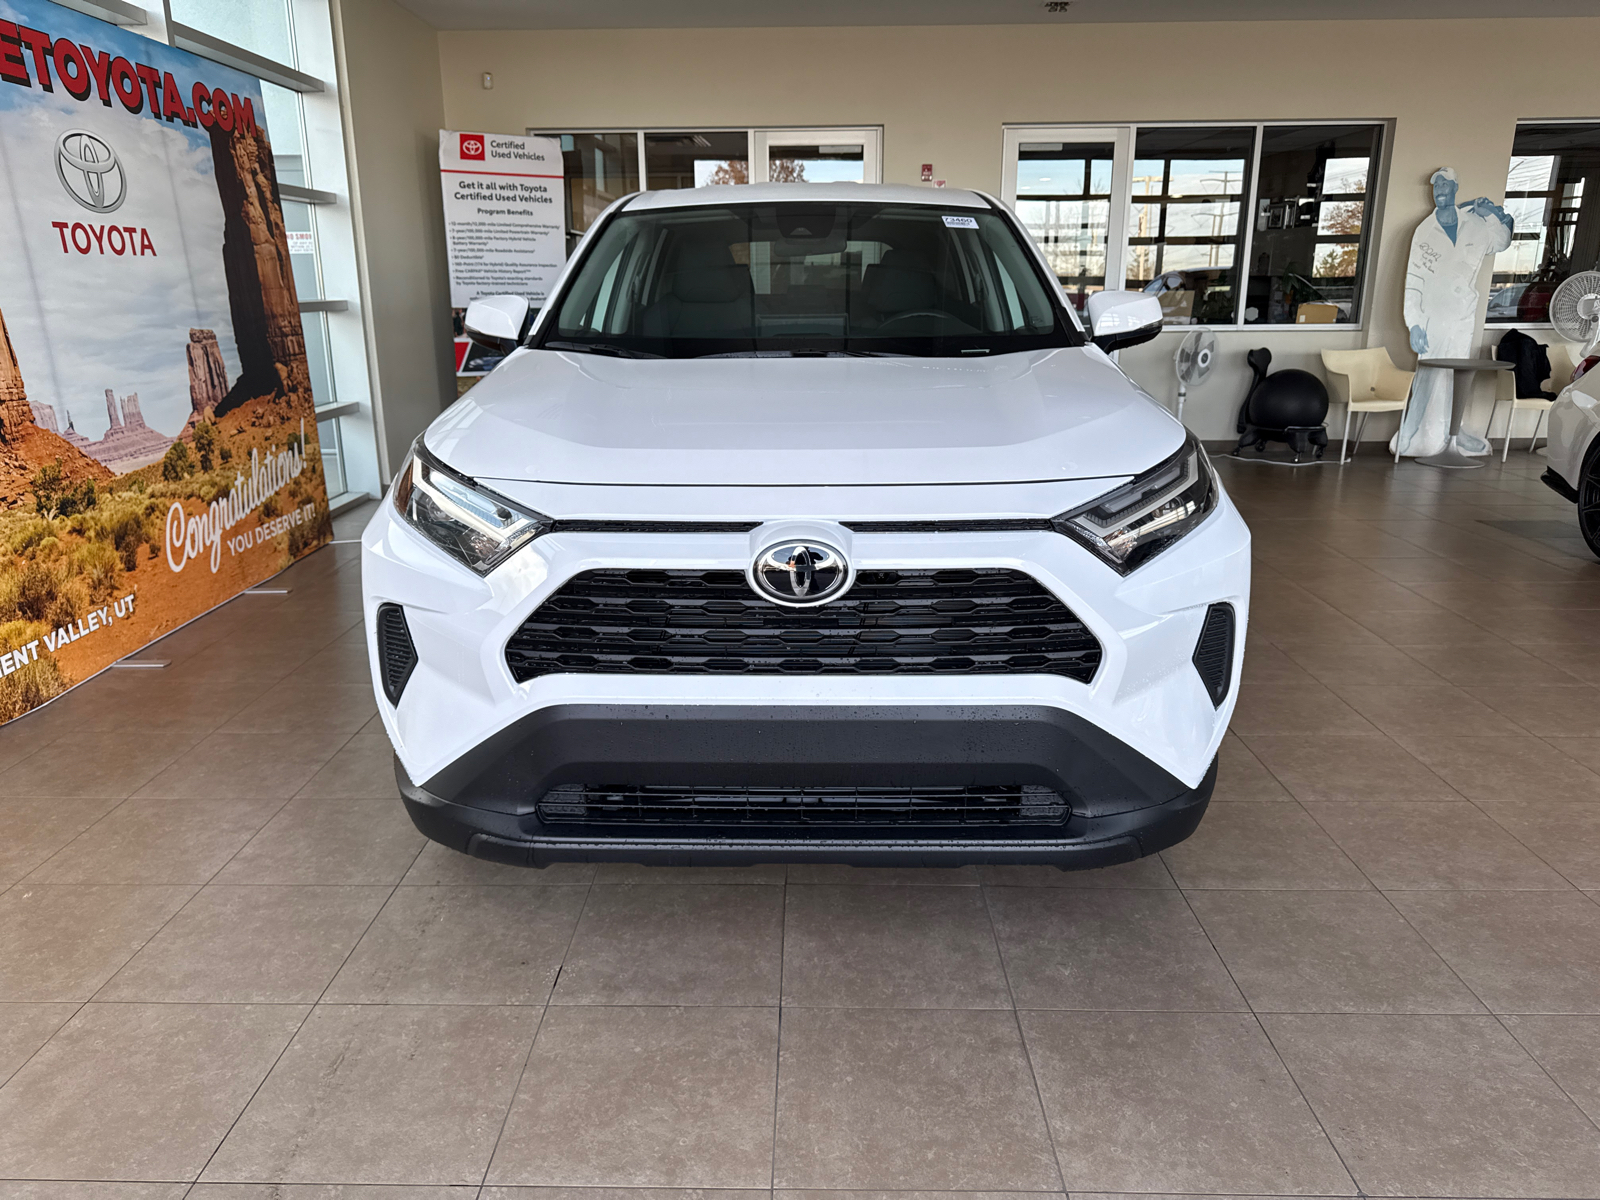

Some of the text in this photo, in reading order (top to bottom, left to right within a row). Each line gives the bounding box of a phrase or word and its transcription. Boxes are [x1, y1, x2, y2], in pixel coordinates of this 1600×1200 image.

[490, 140, 525, 150] Certified
[491, 150, 545, 161] Used Vehicles
[454, 192, 493, 201] Certified
[518, 194, 552, 204] Vehicles
[459, 181, 547, 194] Get it all with Toyota
[52, 222, 157, 256] TOYOTA
[166, 416, 307, 574] Congratulations!
[227, 502, 316, 556] YOU DESERVE IT!
[0, 594, 134, 678] ENT VALLEY, UT
